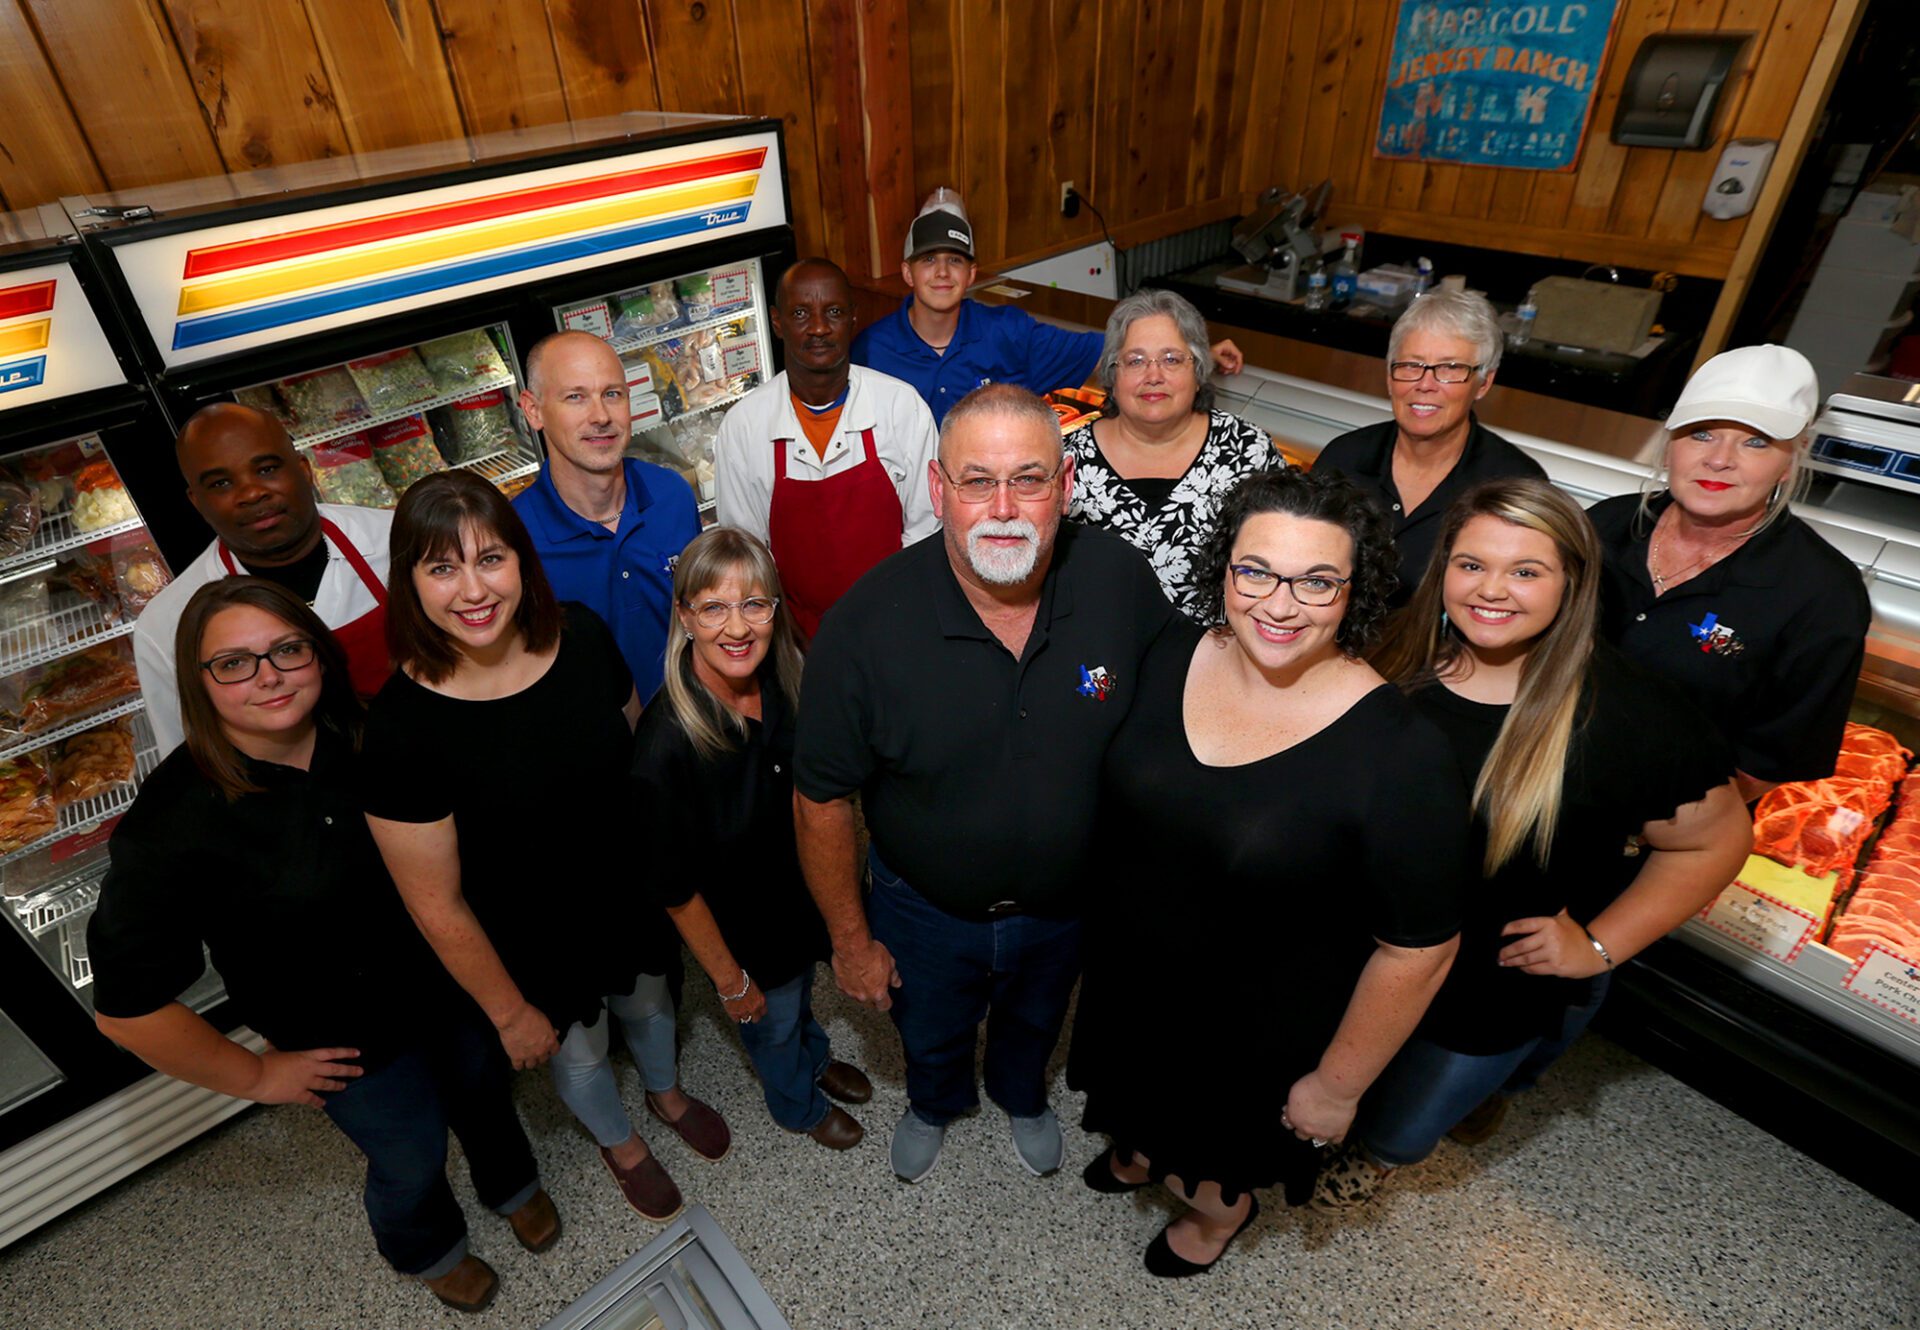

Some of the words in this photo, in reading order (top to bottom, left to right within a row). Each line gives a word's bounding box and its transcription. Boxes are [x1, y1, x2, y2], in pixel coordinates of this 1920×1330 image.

[1391, 47, 1489, 88] JERSEY
[1494, 47, 1589, 90] RANCH
[1413, 81, 1556, 124] MILK
[1874, 978, 1901, 995] Pork
[1884, 971, 1920, 992] Center
